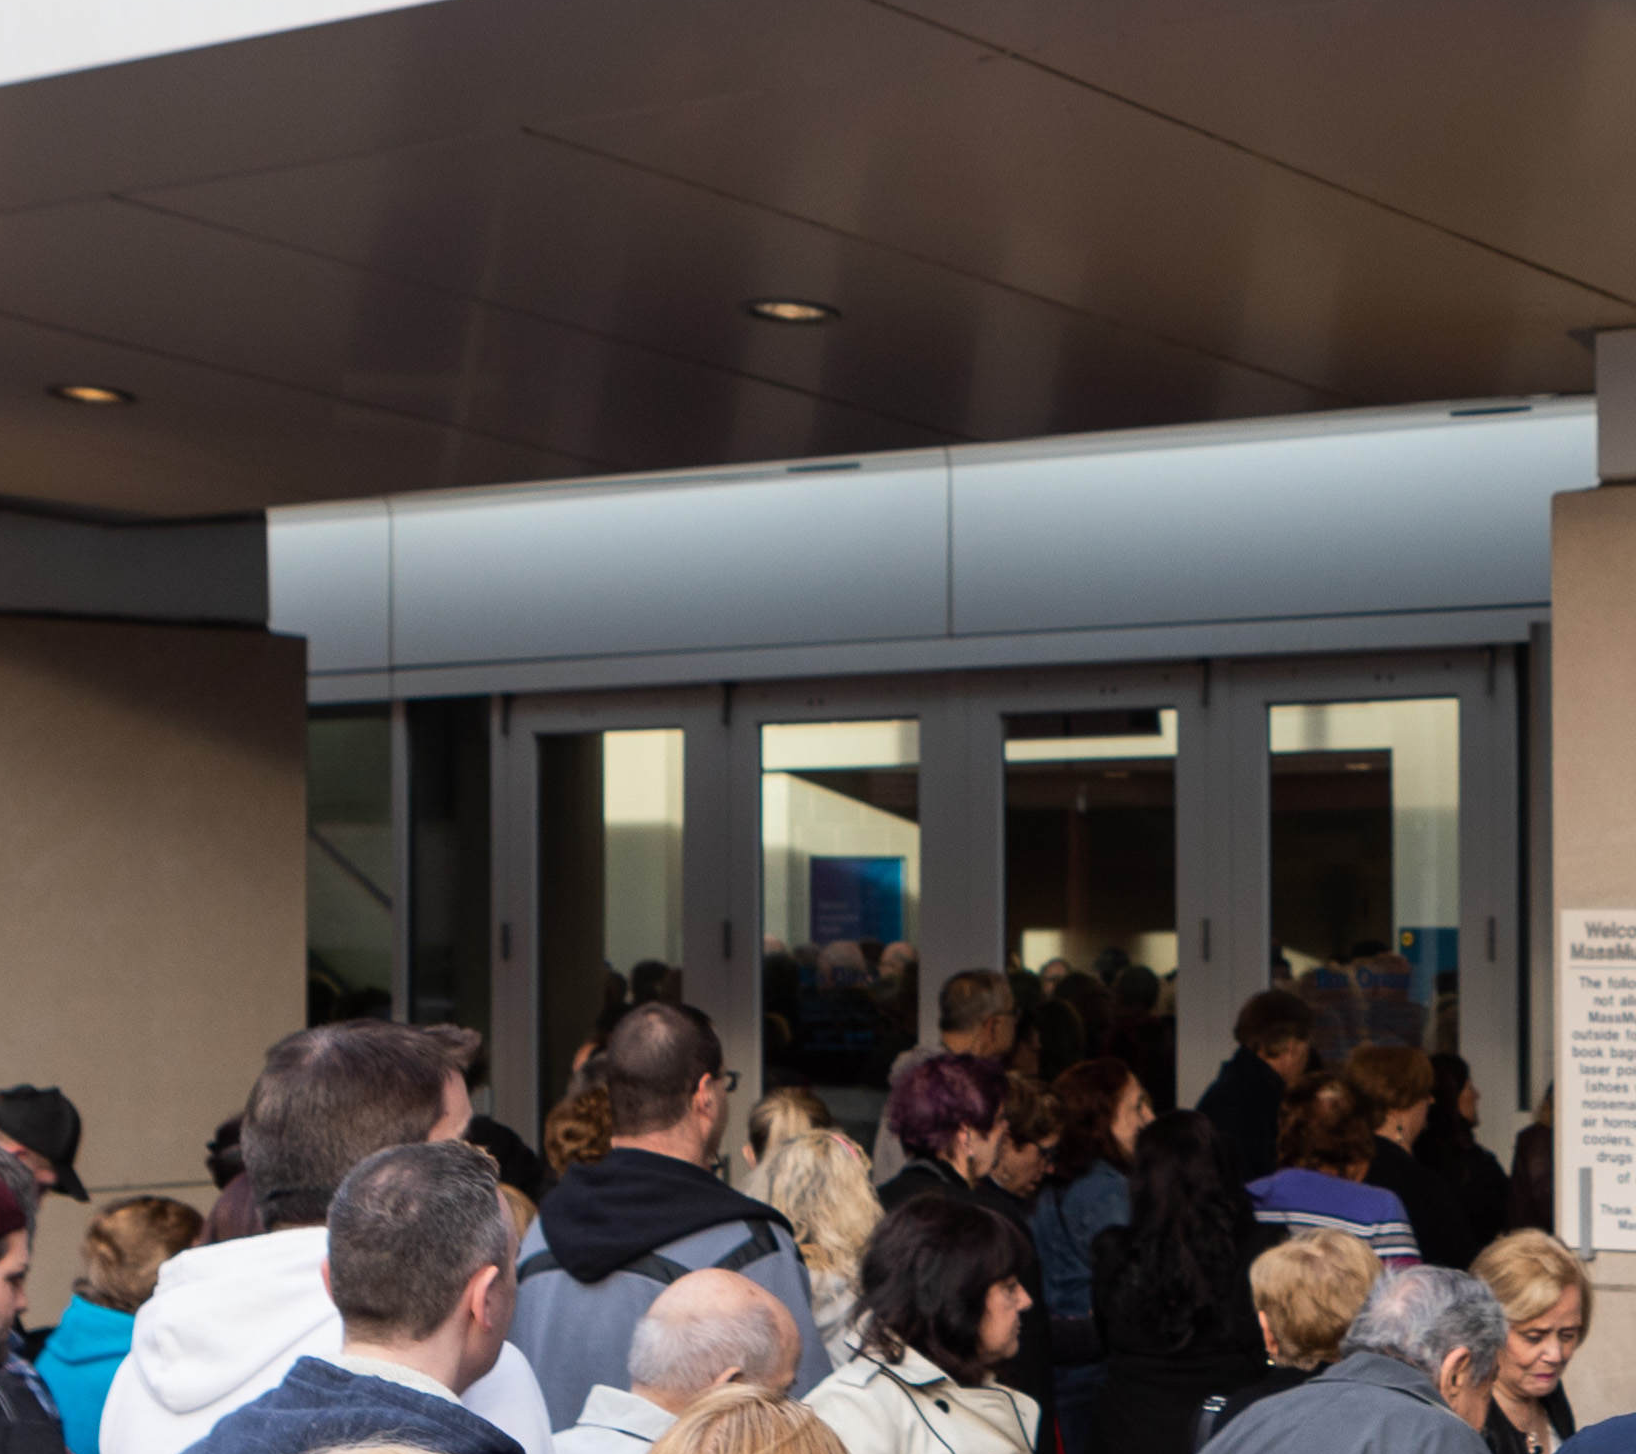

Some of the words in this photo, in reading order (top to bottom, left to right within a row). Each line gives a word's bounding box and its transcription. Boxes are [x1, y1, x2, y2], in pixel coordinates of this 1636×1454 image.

[1579, 975, 1602, 989] The
[1593, 995, 1614, 1007] not
[1571, 1029, 1620, 1041] outside
[1571, 1046, 1604, 1059] book
[1579, 1063, 1611, 1076] laser
[1581, 1117, 1598, 1128] air
[1596, 1151, 1633, 1166] drugs
[1617, 1172, 1630, 1184] of
